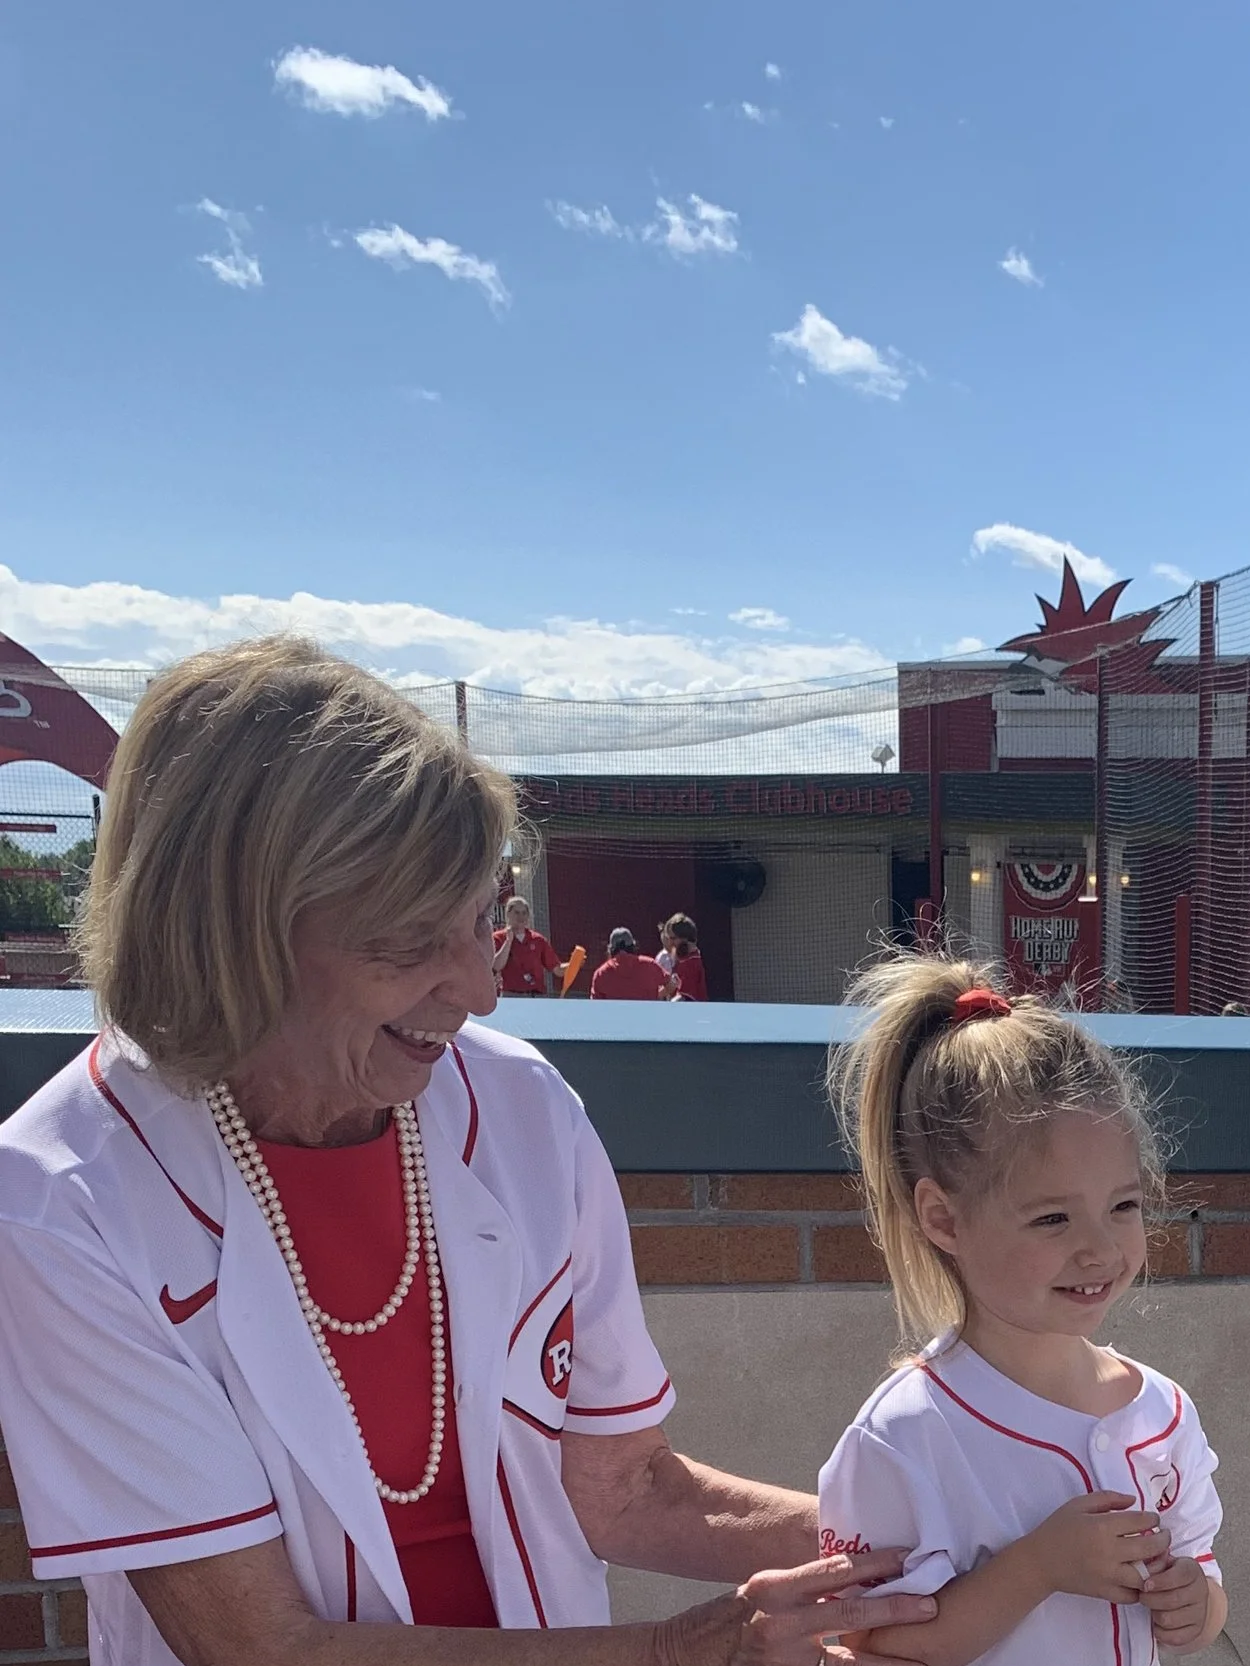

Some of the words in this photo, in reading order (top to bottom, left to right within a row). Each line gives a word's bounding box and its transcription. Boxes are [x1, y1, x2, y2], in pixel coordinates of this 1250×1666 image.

[725, 780, 912, 815] Clubhouse
[1009, 916, 1052, 940] HOME
[1023, 940, 1071, 963] DERBY
[820, 1528, 872, 1555] Reds
